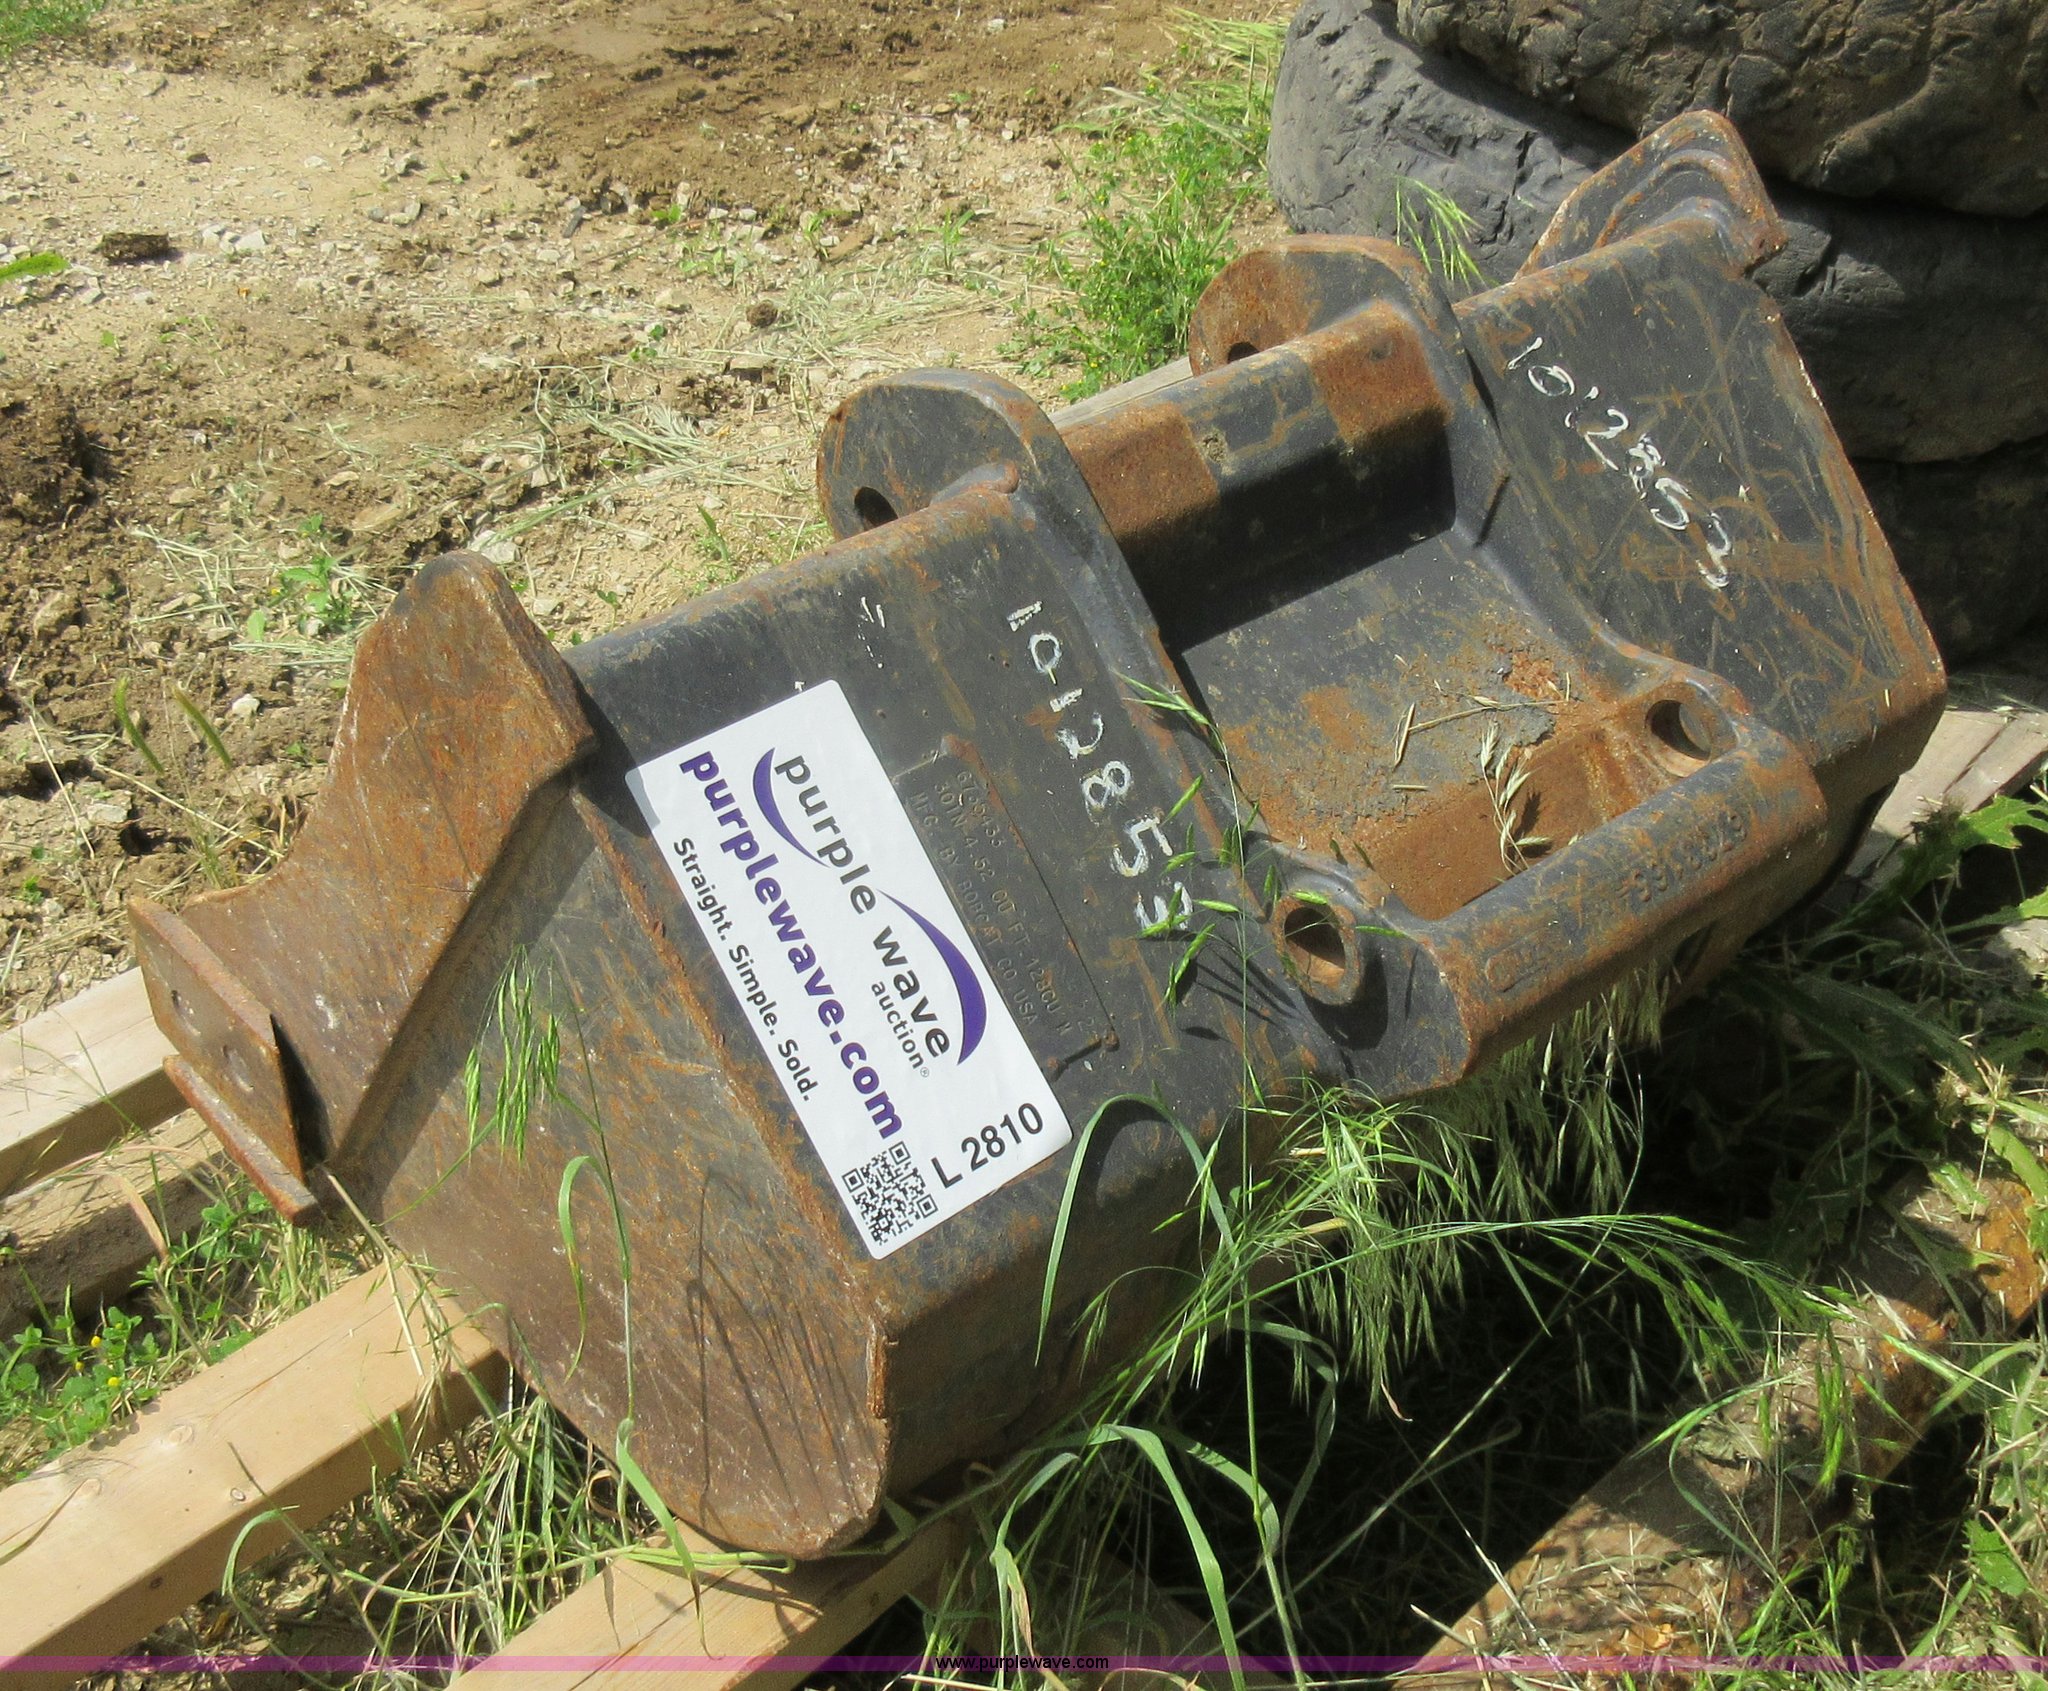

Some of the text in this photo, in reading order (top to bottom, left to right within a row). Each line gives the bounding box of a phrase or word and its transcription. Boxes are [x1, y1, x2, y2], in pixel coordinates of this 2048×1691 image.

[674, 837, 819, 1102] Straight. Simple. Sold.
[679, 750, 903, 1140] purplewave.com
[774, 755, 951, 1058] purple wave
[931, 1103, 1044, 1189] L 2810
